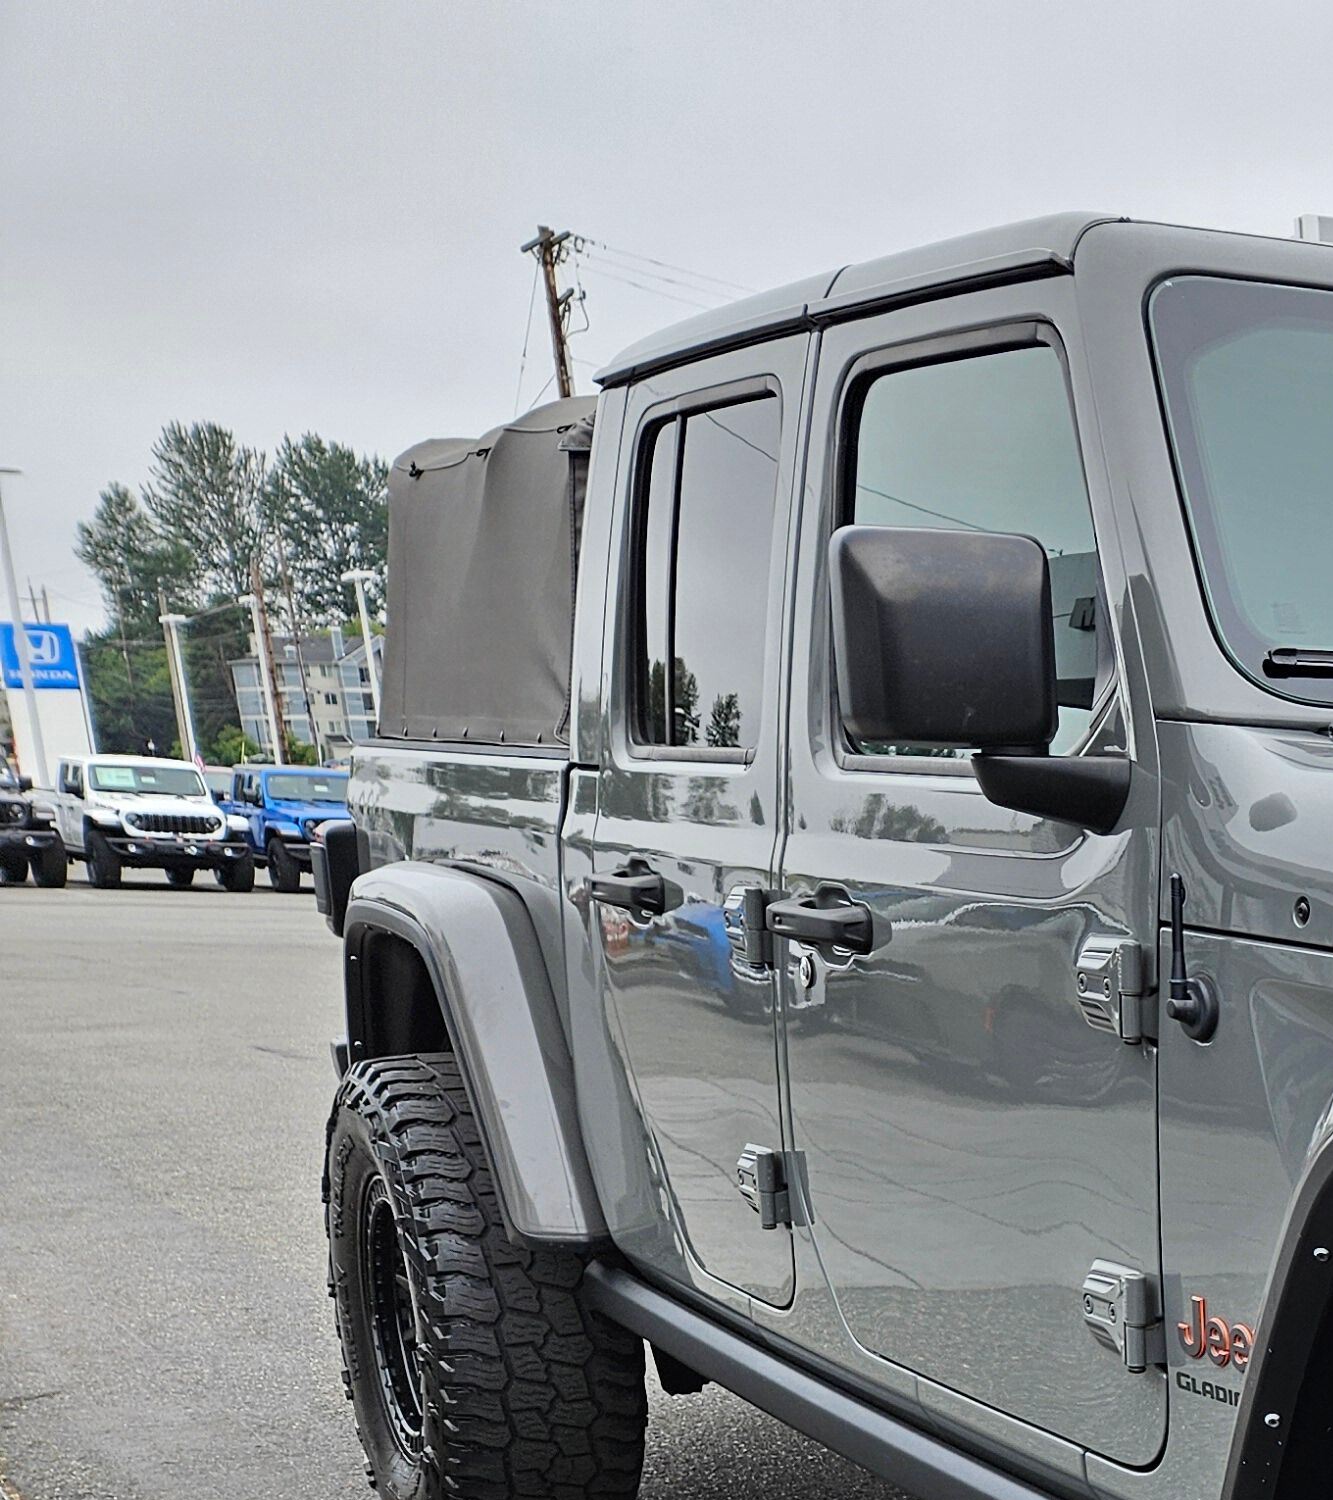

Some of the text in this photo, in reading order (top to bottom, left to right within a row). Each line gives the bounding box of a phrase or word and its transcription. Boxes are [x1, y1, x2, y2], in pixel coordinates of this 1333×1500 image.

[8, 668, 75, 681] HNDA
[1176, 1295, 1256, 1373] Jee
[1175, 1371, 1242, 1408] GLADI
